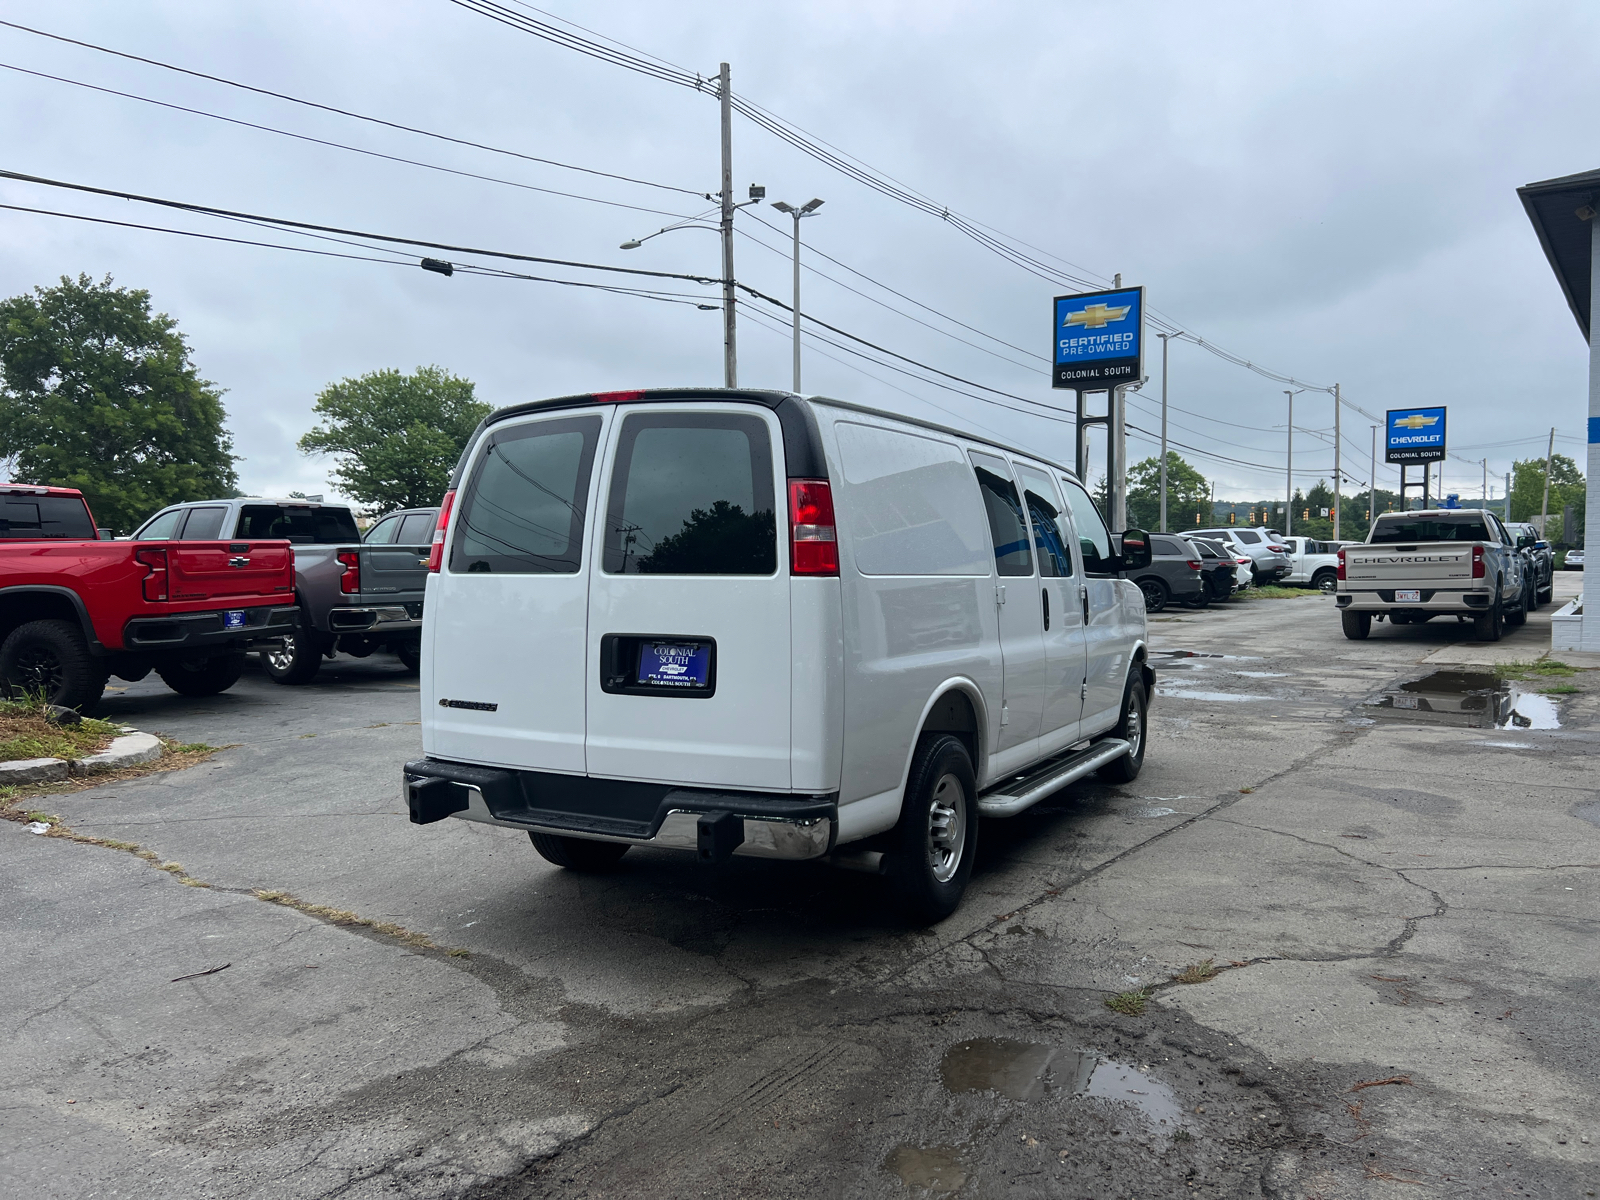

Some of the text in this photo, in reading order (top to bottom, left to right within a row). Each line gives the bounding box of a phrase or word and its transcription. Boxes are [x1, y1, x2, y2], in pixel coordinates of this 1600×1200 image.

[1060, 332, 1133, 348] CERTIFIED
[1063, 342, 1129, 356] PRE-OWNED
[1061, 366, 1131, 379] COLONIAL SOUTH
[1391, 435, 1441, 444] CHEVROLET
[1353, 555, 1463, 564] CHEVROLET
[654, 647, 696, 657] COLONIAL
[659, 656, 688, 664] SOUTH
